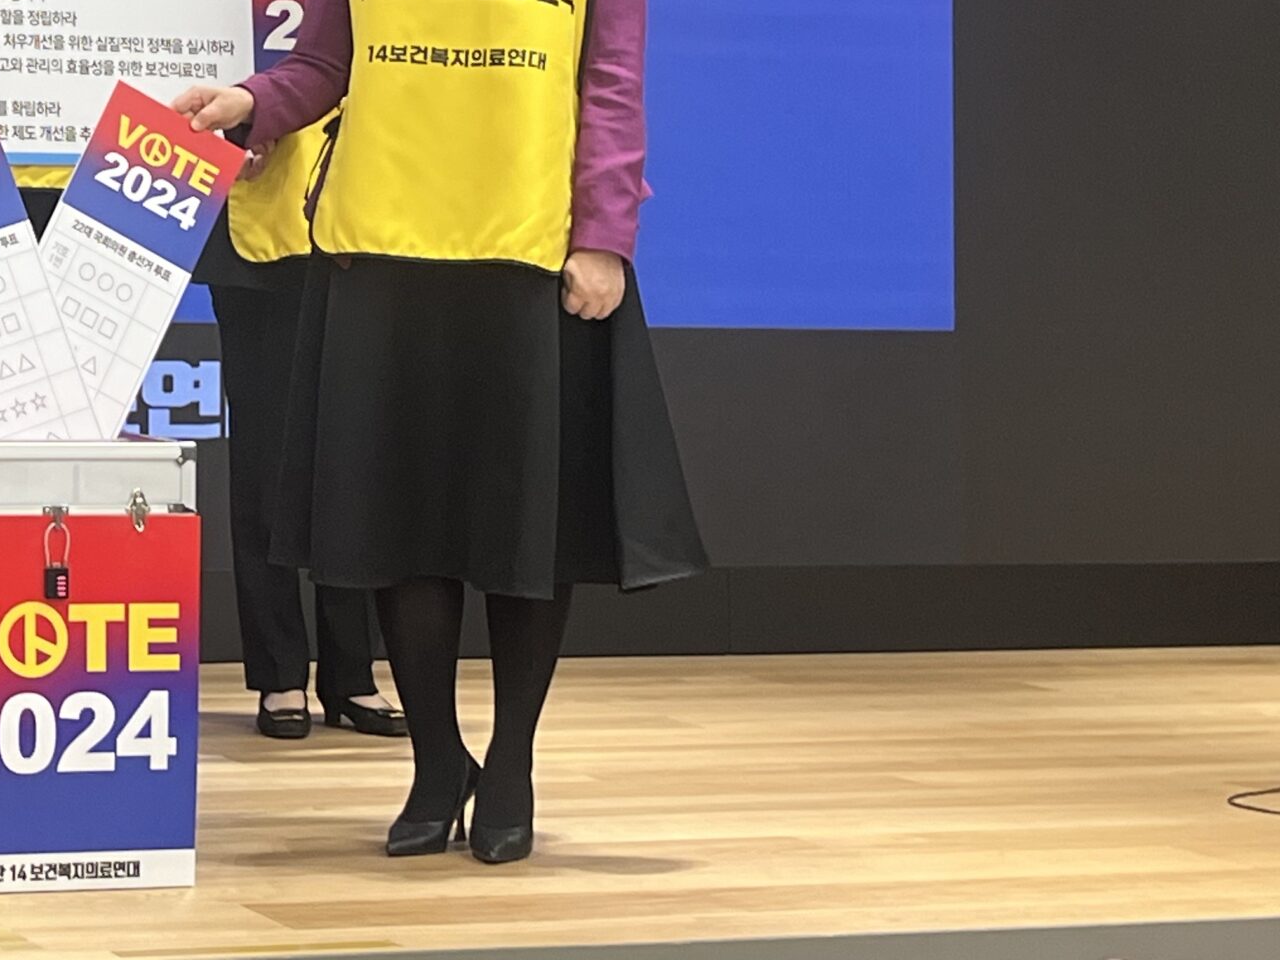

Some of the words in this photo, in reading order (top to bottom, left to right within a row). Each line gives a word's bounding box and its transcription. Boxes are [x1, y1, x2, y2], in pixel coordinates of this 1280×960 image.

[27, 10, 77, 27] 정립하라
[69, 35, 93, 52] 위한
[96, 36, 144, 53] 실질적인
[147, 37, 183, 55] 정책을
[186, 39, 235, 56] 실시하라
[26, 58, 63, 74] 관리의
[66, 59, 115, 76] 효율성을
[118, 61, 143, 77] 위한
[145, 62, 218, 79] 보건의료인력
[11, 100, 61, 117] 확립하라
[11, 125, 37, 141] 제도
[40, 126, 77, 142] 개선을
[120, 115, 220, 197] VOTE
[95, 152, 203, 231] 2024
[10, 865, 27, 881] 14
[29, 861, 140, 881] 보건복지의료연대
